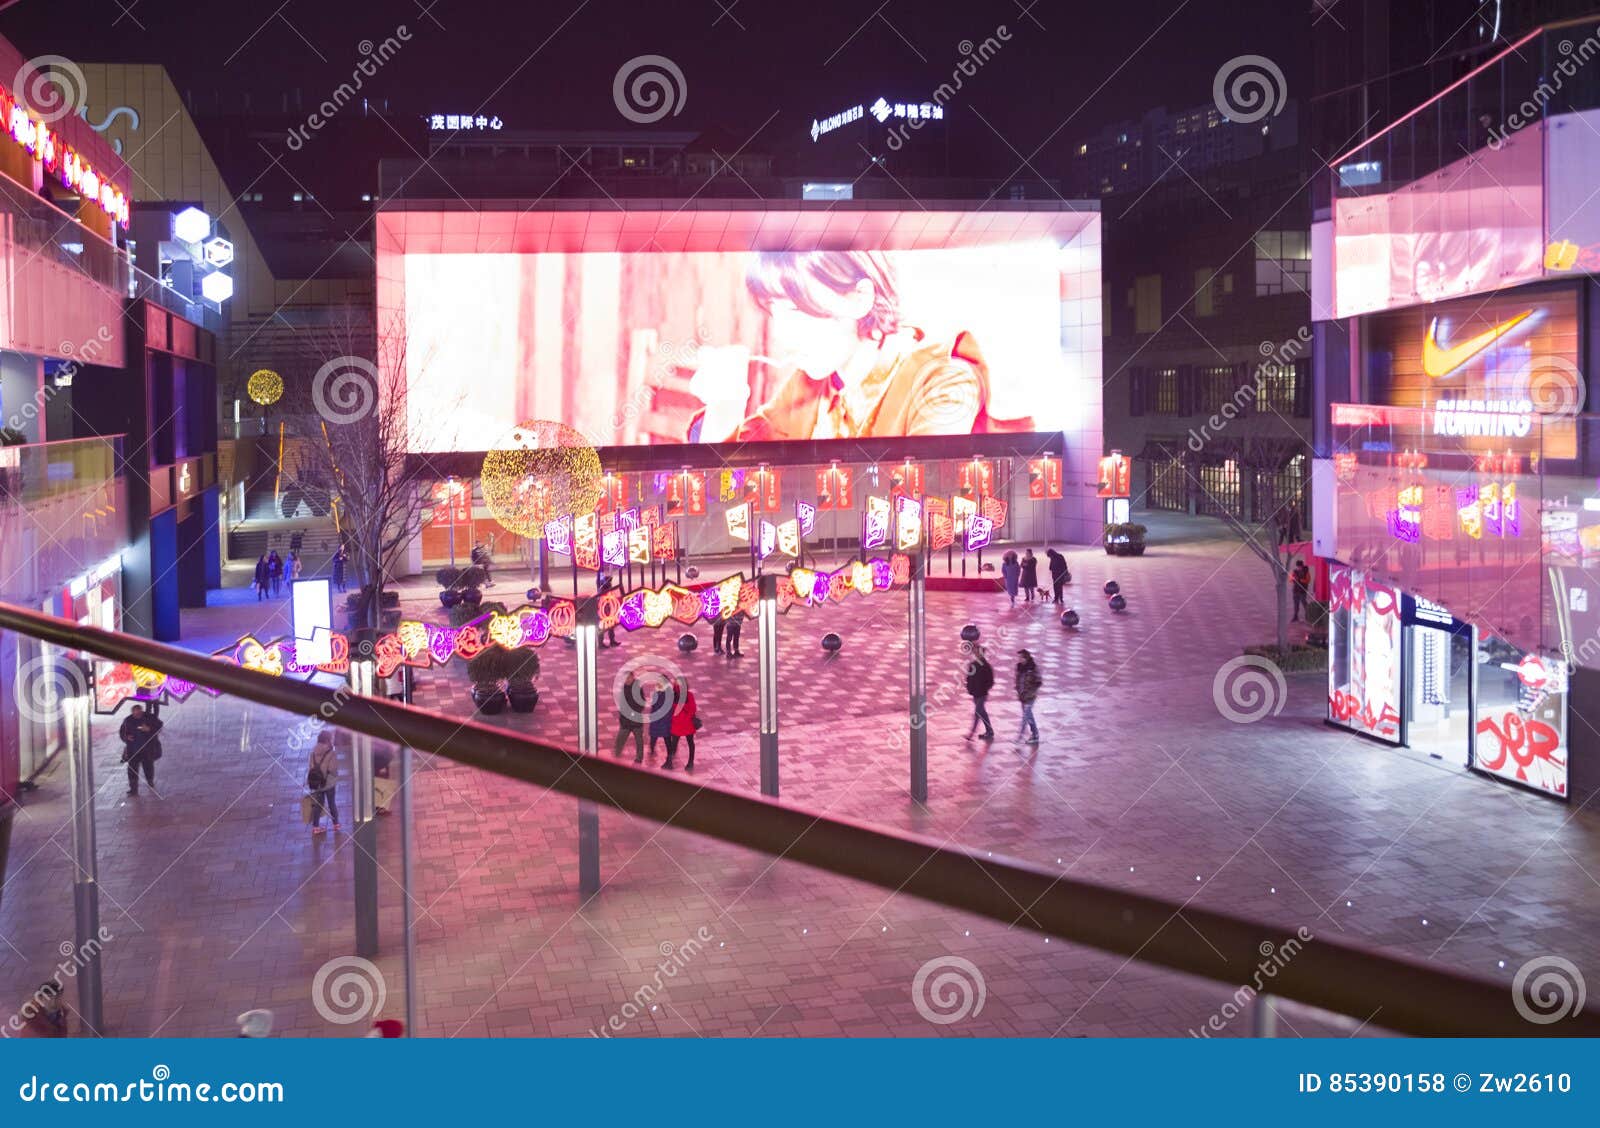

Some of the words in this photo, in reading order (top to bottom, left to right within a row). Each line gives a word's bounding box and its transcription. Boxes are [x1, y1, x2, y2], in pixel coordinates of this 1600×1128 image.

[426, 114, 503, 130] 茂国际中心
